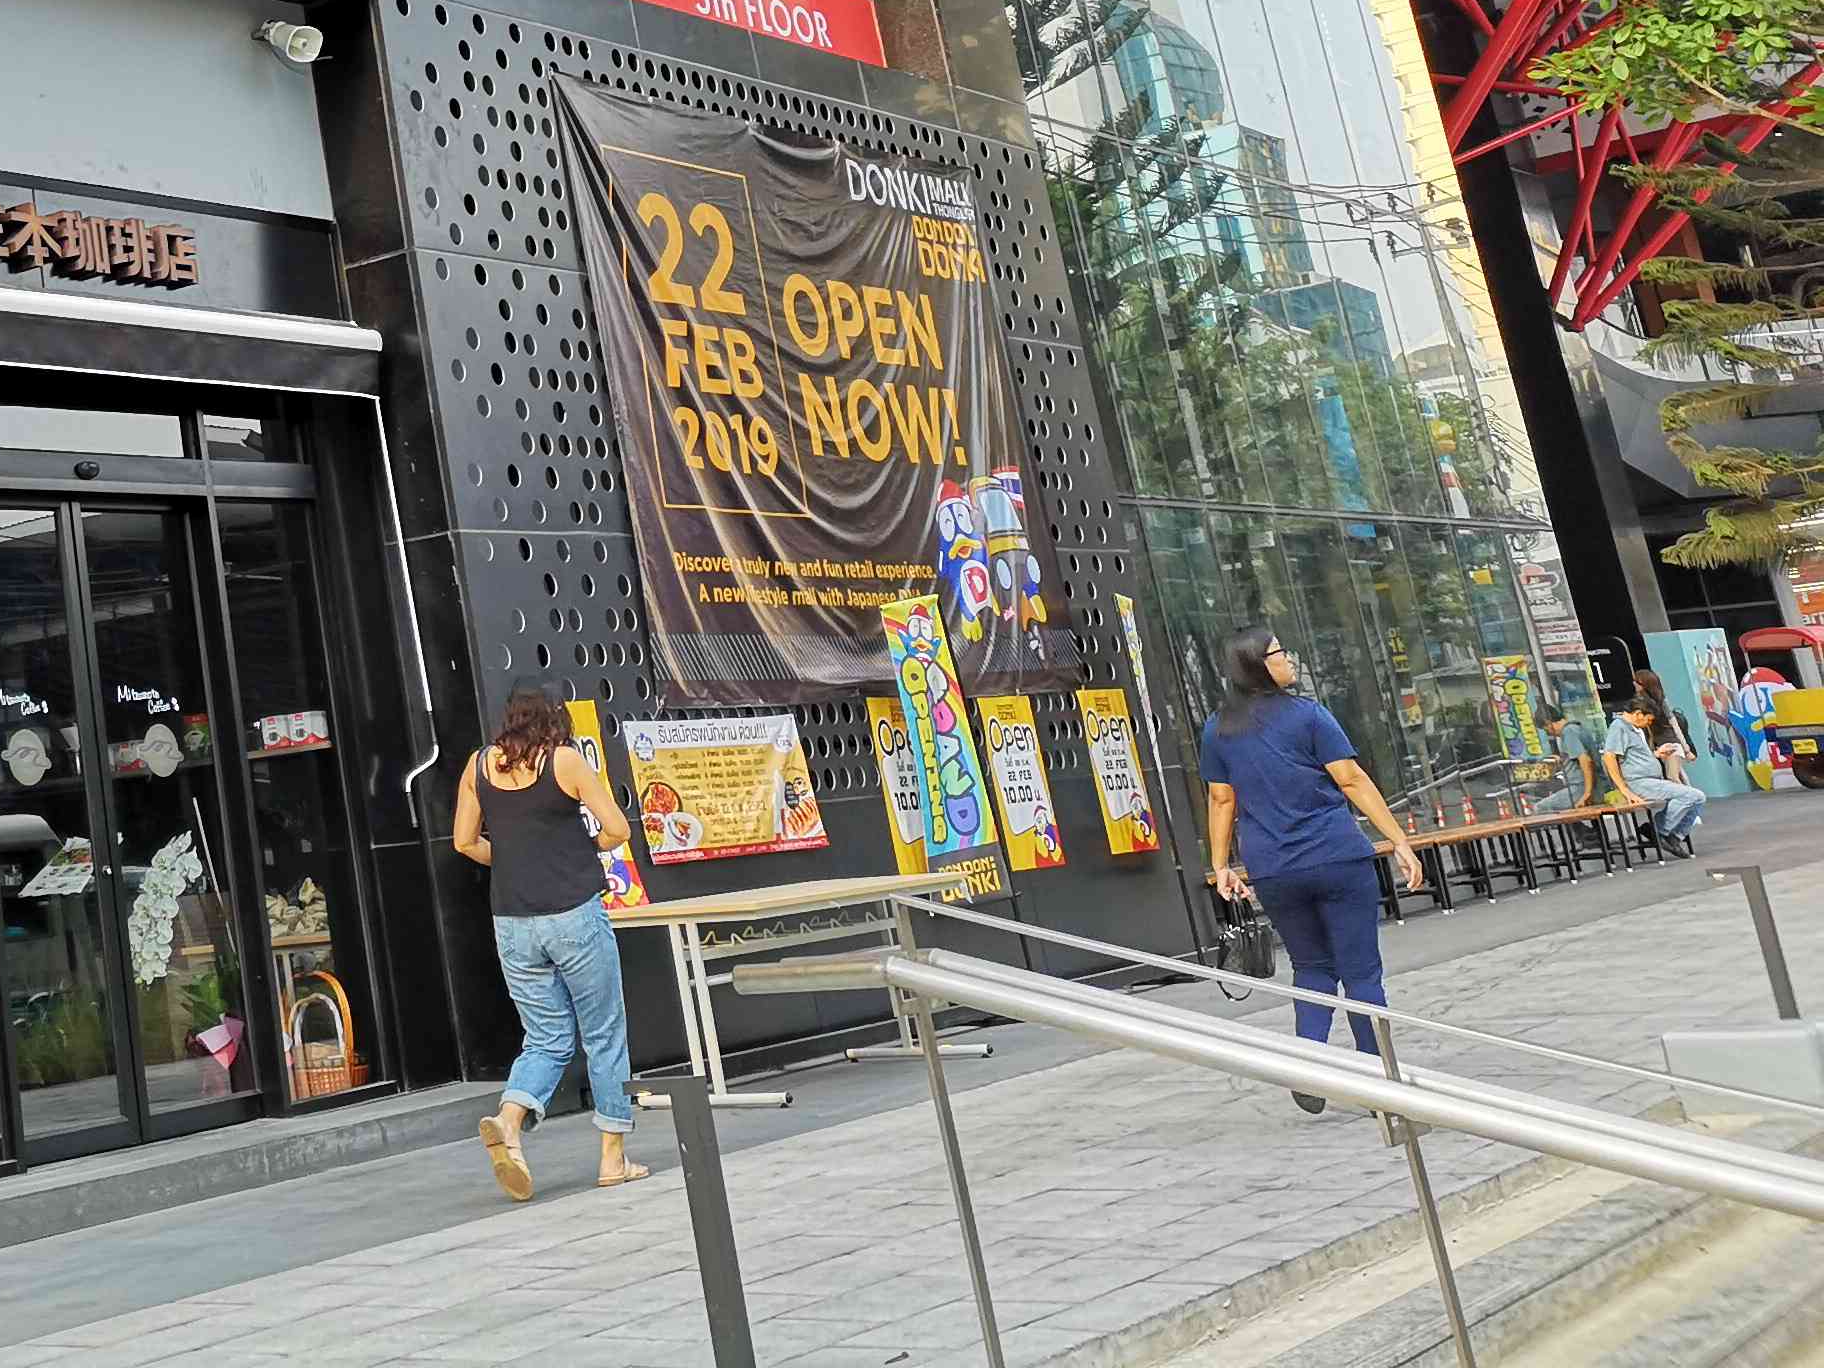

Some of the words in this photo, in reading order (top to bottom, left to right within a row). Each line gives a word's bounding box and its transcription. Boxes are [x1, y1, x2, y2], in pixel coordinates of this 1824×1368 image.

[845, 158, 932, 215] DONKI
[637, 192, 747, 316] 22
[783, 273, 944, 370] OPEN
[661, 318, 764, 399] FEB
[798, 373, 968, 467] NOW!
[673, 407, 779, 477] 2019
[742, 556, 771, 578] truly
[799, 558, 823, 577] and
[823, 559, 844, 578] fun
[844, 560, 874, 578] retail
[876, 561, 937, 581] experience.
[699, 583, 711, 602] A
[713, 586, 744, 603] new
[792, 586, 816, 606] mall
[817, 586, 844, 606] with
[847, 588, 897, 610] Japanese
[1592, 661, 1605, 683] 1
[878, 719, 914, 759] Op
[989, 718, 1036, 755] Open
[1087, 710, 1131, 745] Open
[1003, 785, 1034, 805] 10.00
[1102, 773, 1130, 792] 10.00
[894, 791, 921, 812] 10.0
